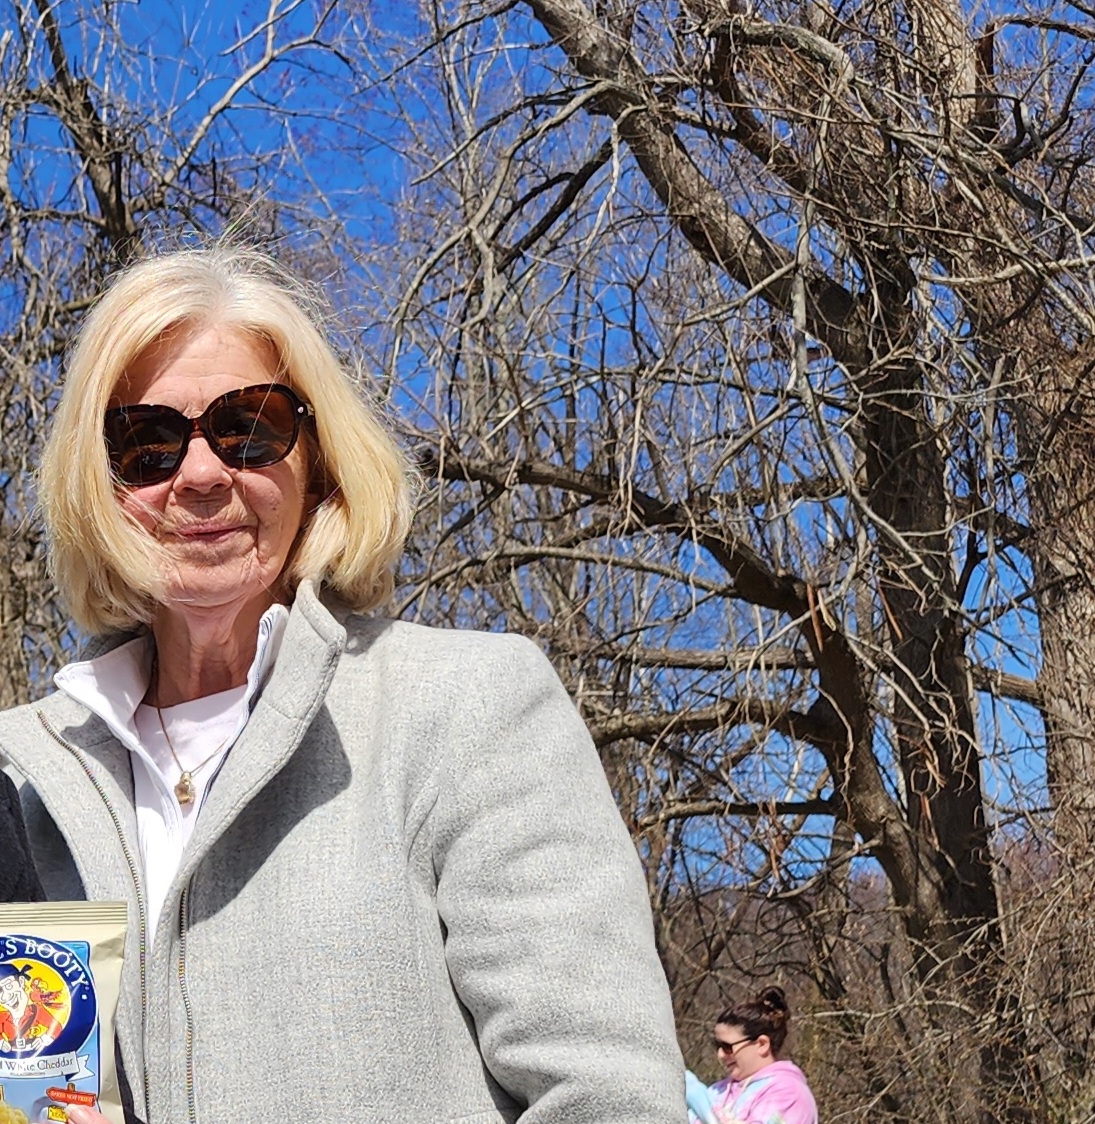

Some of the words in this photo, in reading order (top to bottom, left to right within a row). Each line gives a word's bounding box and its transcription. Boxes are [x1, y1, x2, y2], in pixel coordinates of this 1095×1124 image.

[24, 938, 89, 988] BOOTY
[3, 1060, 35, 1072] White
[36, 1056, 73, 1071] Cheddar
